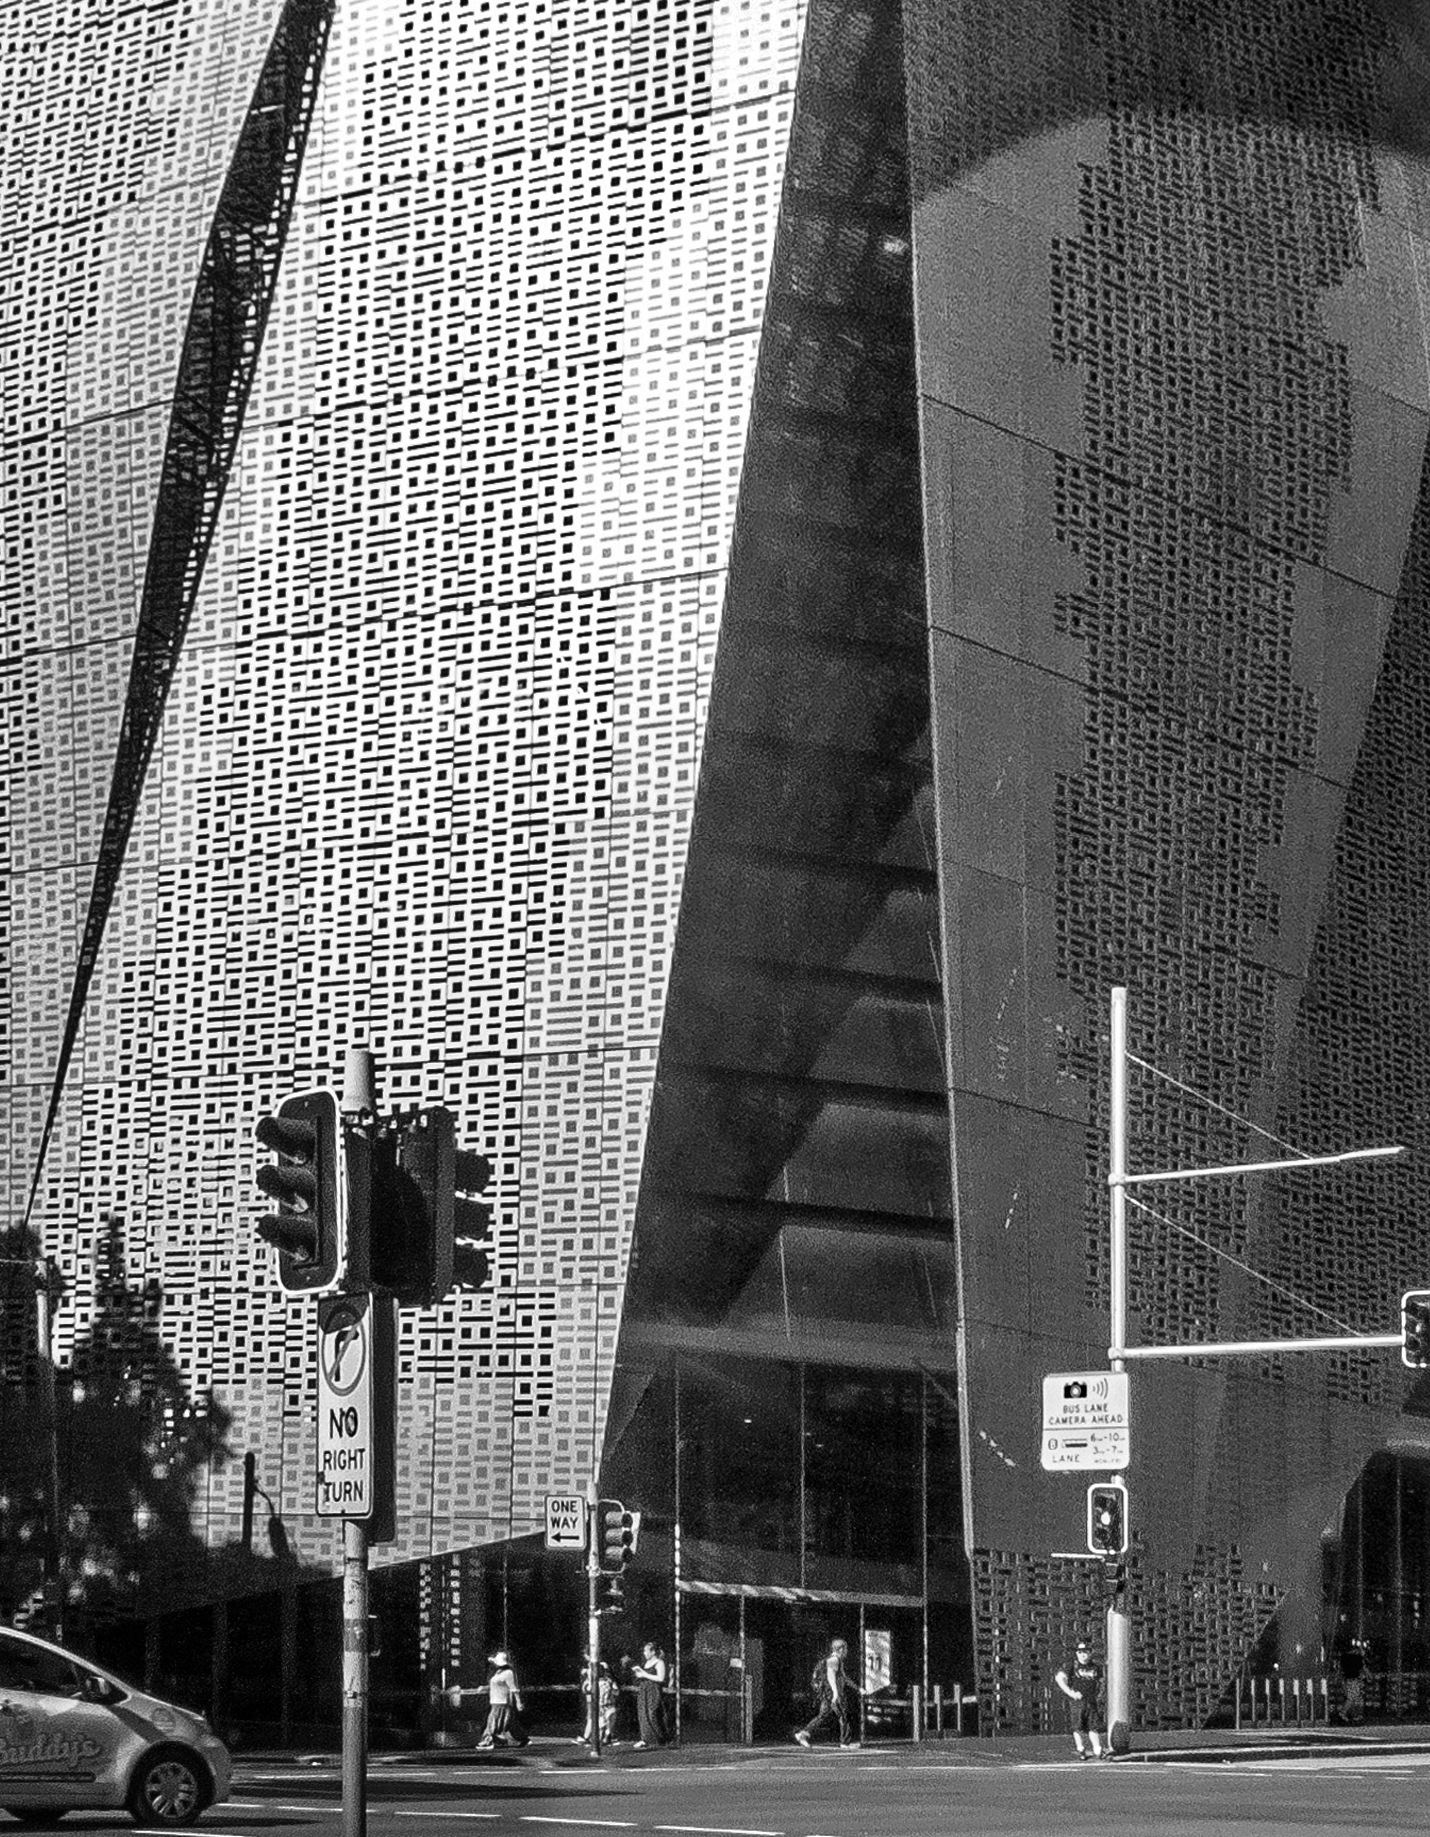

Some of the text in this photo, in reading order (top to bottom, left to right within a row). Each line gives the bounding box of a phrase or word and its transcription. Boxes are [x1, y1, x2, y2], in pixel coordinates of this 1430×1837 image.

[1084, 1403, 1109, 1413] LANE
[329, 1406, 359, 1439] NO
[1091, 1414, 1124, 1424] AHEAD
[322, 1448, 366, 1470] RIGHT
[323, 1480, 363, 1502] TURN
[551, 1500, 578, 1513] ONE
[551, 1516, 579, 1530] WAY
